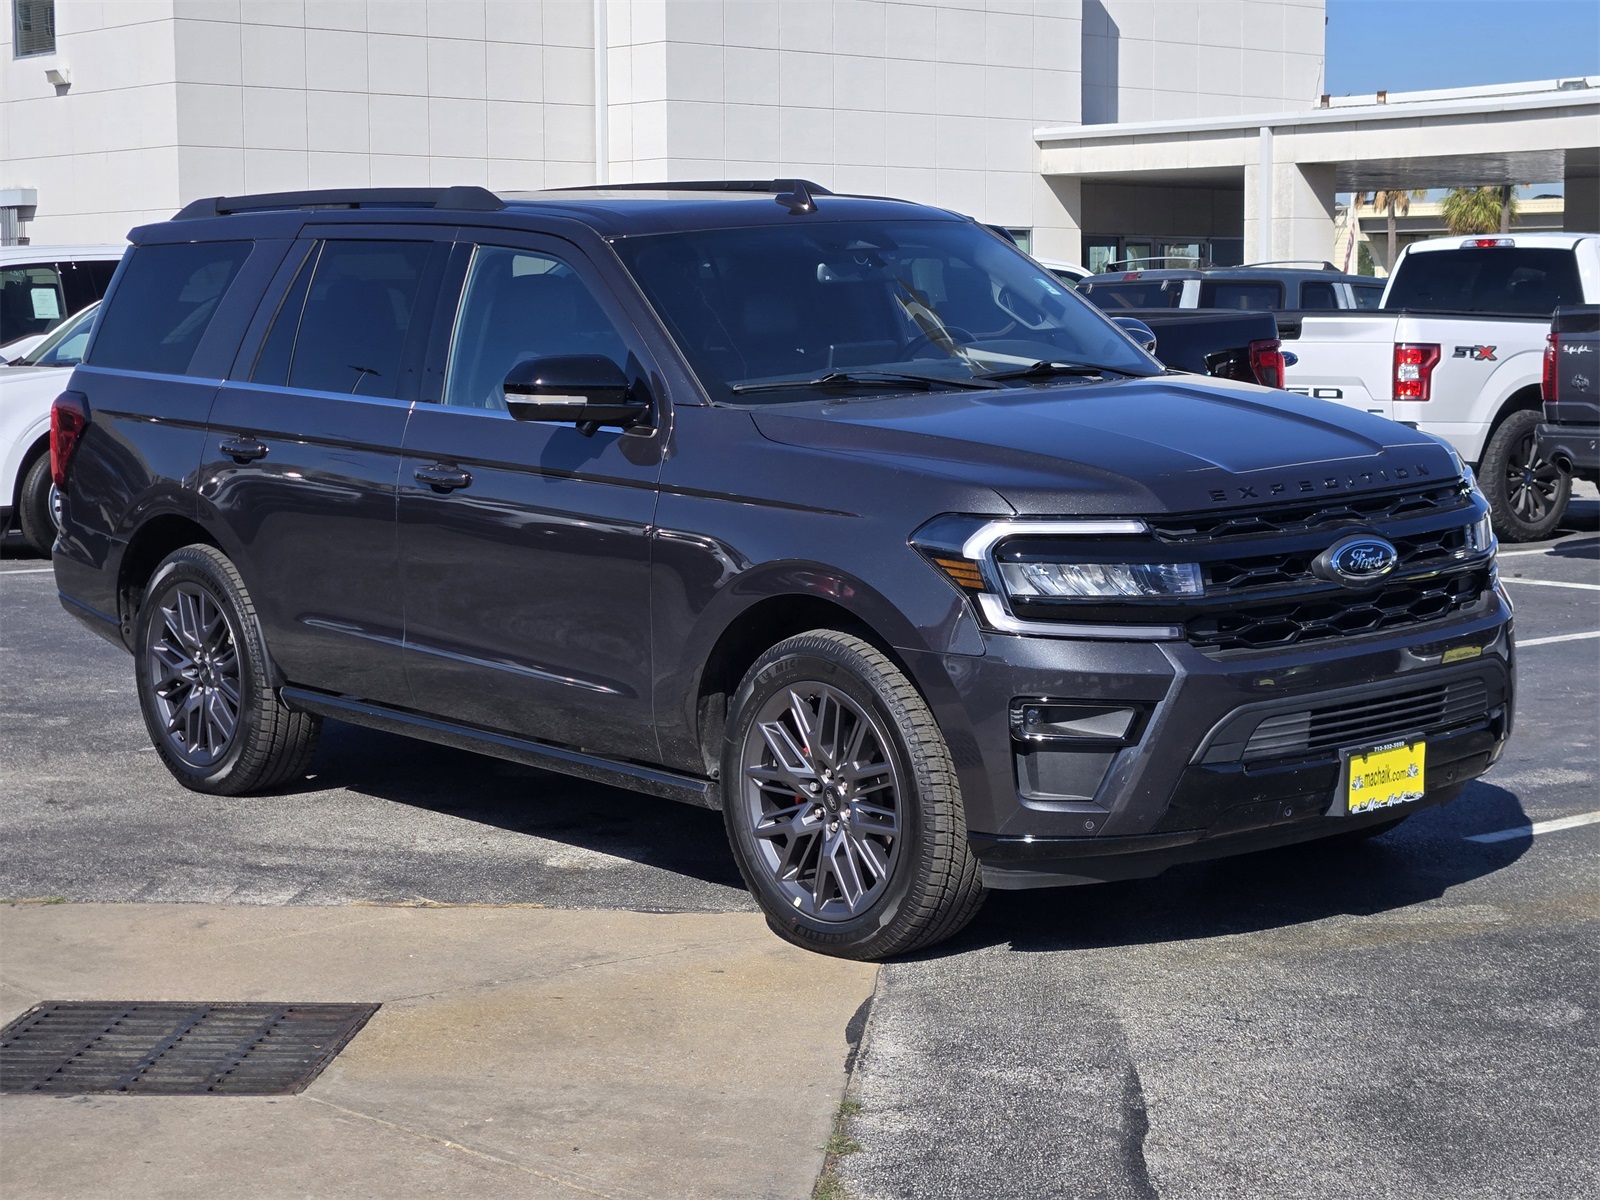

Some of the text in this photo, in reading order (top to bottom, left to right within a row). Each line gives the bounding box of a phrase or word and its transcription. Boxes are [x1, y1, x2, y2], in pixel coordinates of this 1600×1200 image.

[1452, 345, 1498, 361] STX
[1208, 463, 1430, 501] EXPEDITION
[1349, 547, 1384, 571] Ford
